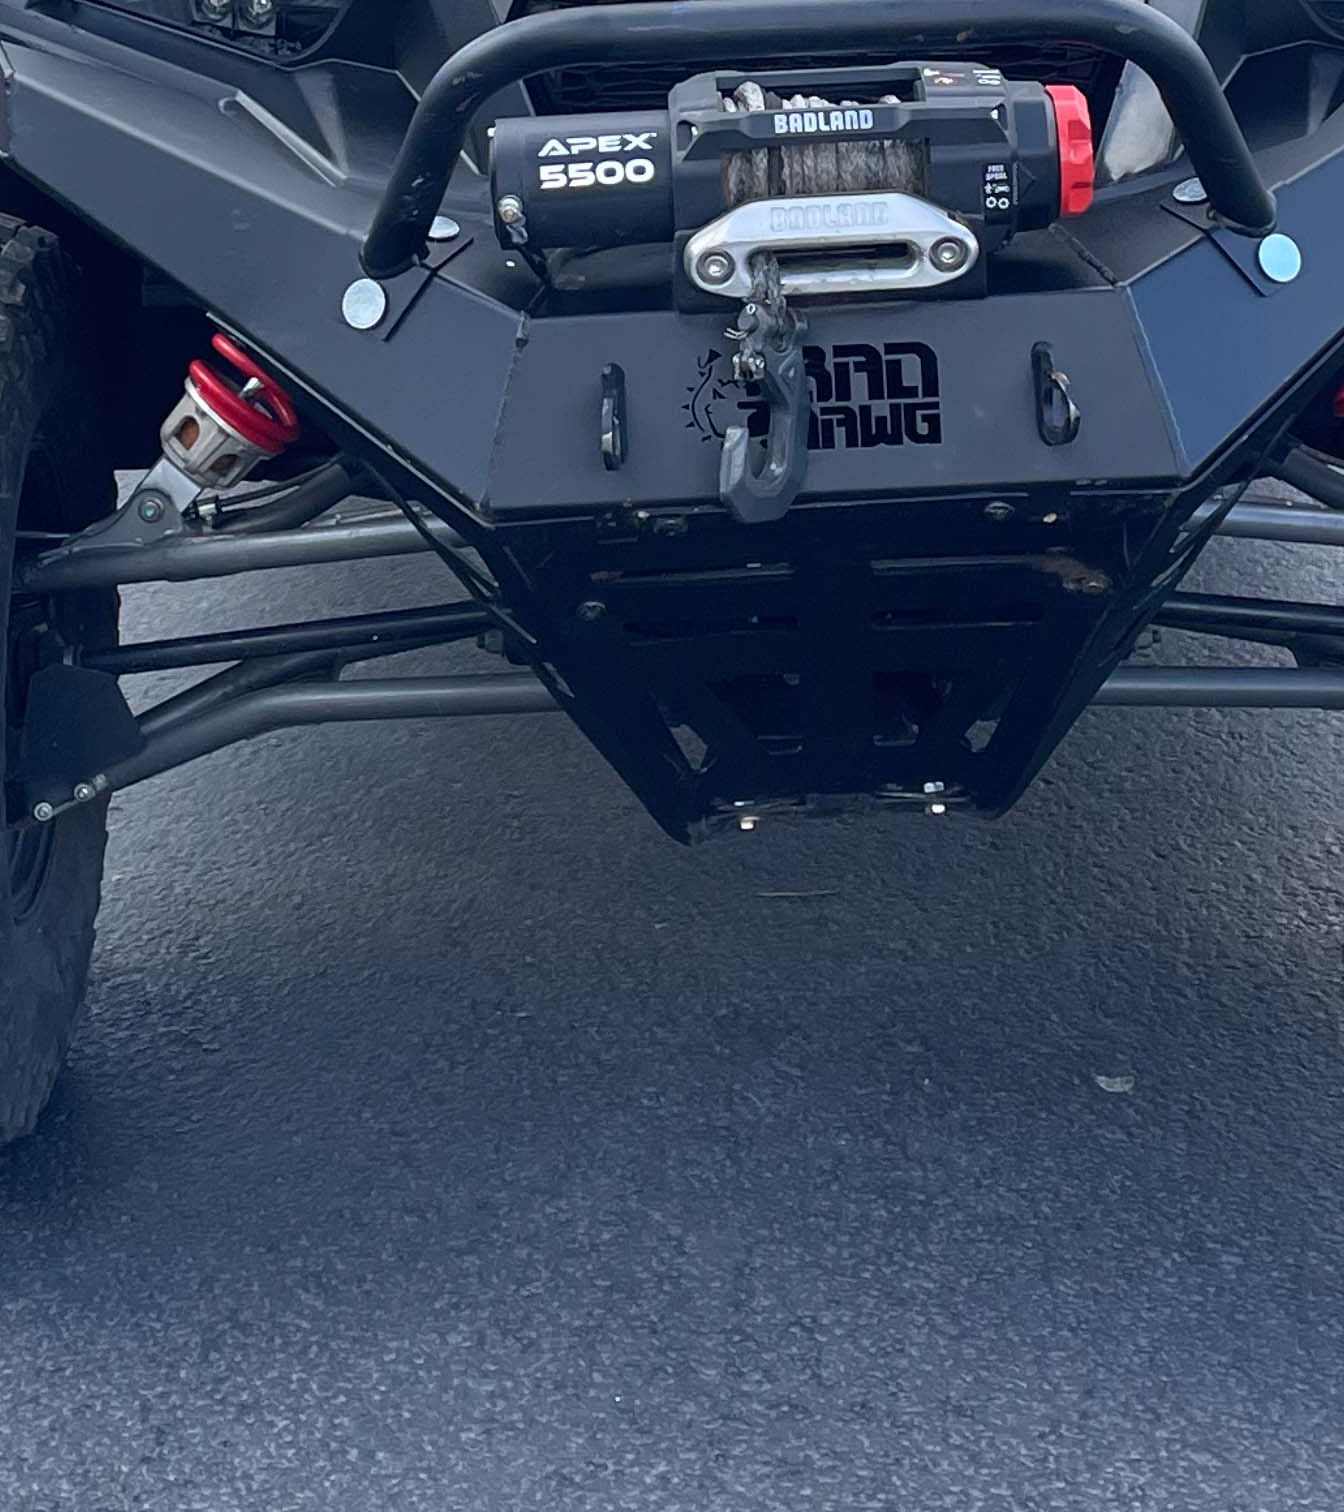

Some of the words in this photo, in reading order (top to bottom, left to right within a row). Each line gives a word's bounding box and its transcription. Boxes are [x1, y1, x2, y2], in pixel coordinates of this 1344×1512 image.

[774, 108, 874, 134] BADLAND
[537, 132, 658, 157] APEX
[539, 158, 655, 189] 5500
[807, 401, 942, 450] AWG
